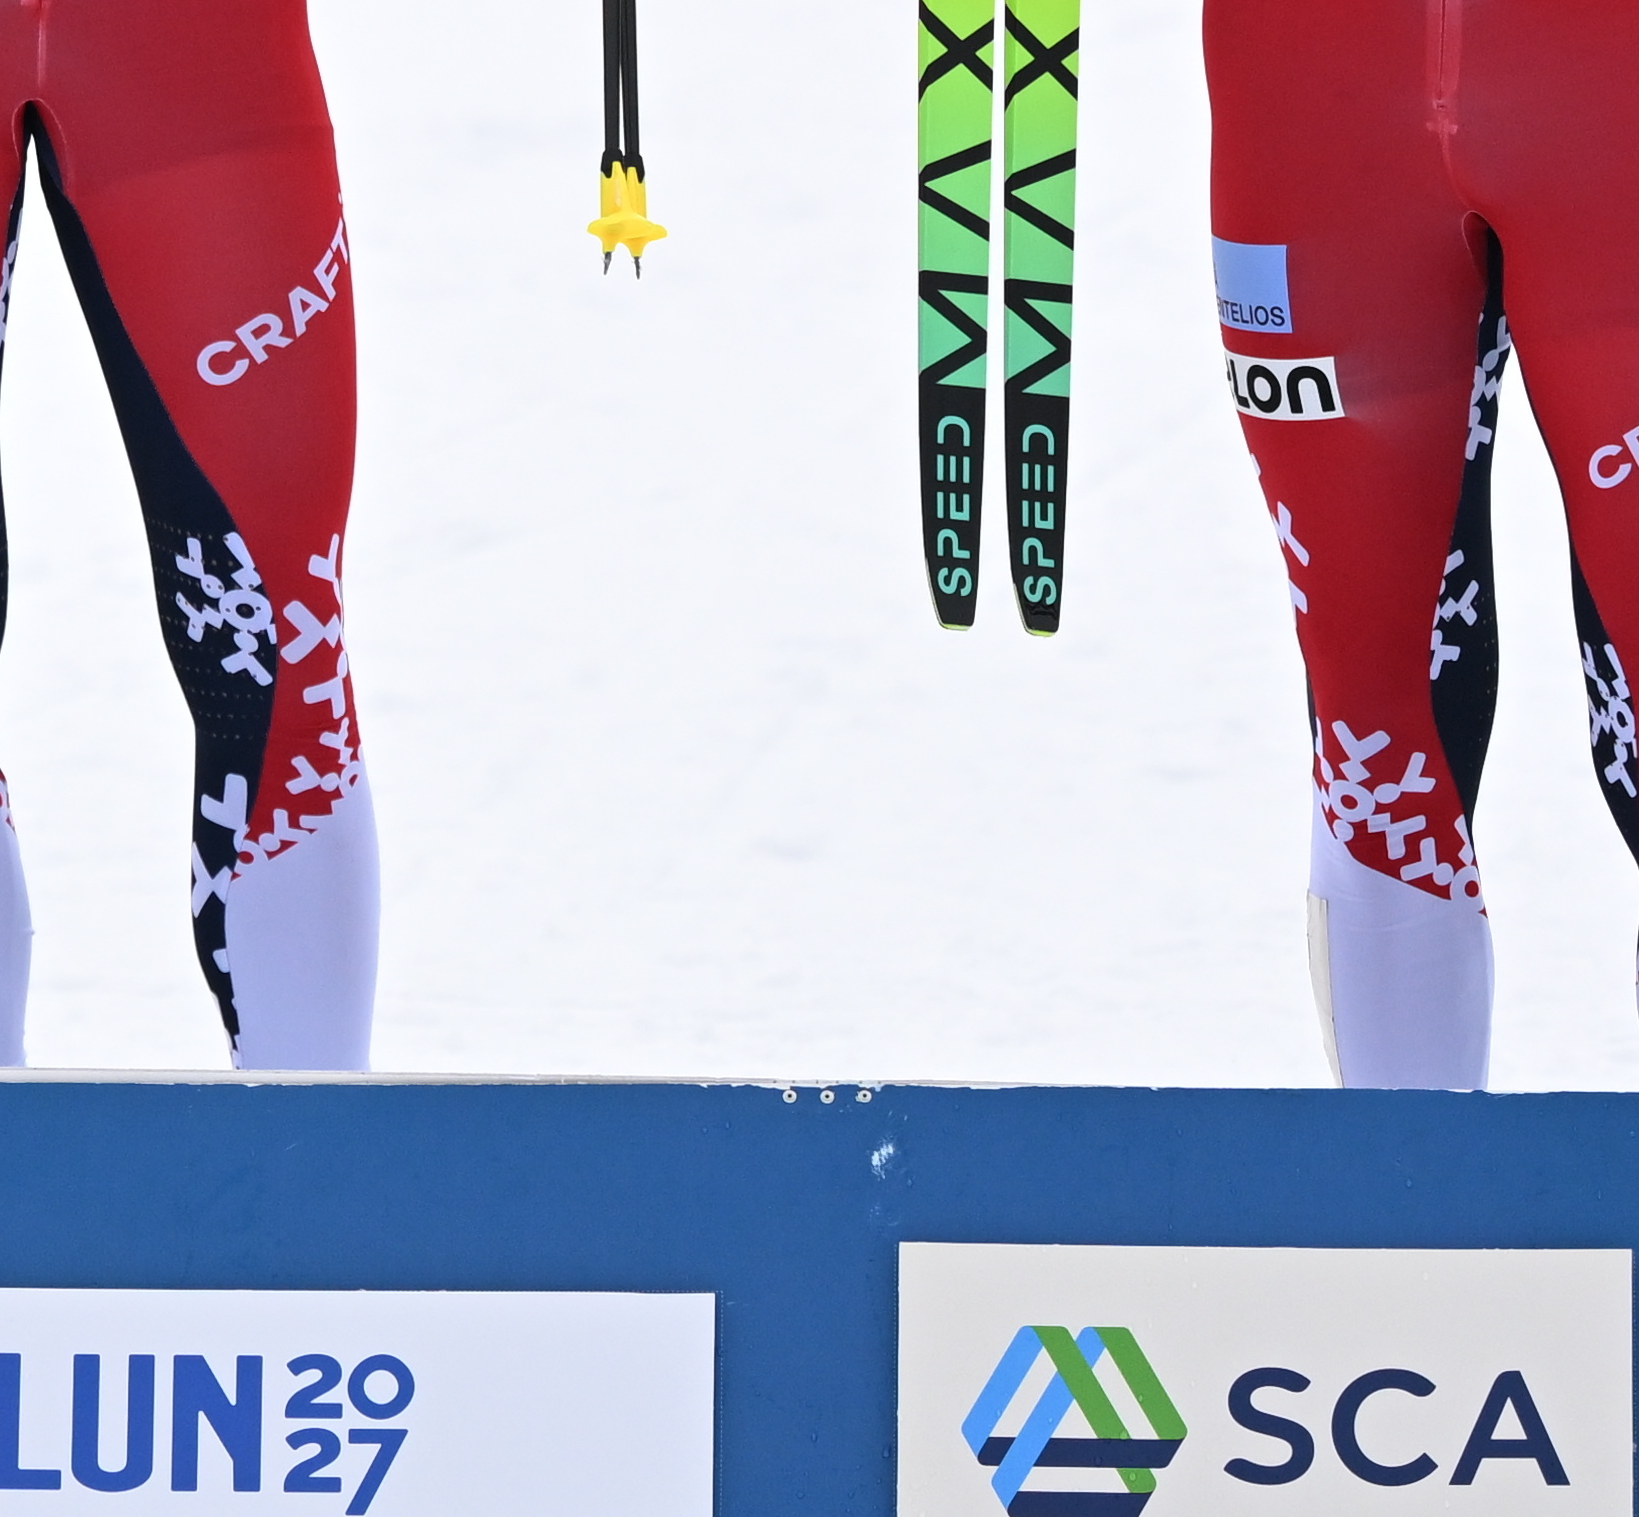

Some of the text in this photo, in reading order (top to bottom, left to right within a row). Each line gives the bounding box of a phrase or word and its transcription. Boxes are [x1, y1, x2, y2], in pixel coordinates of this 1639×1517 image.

[196, 218, 352, 388] CRAFT
[1004, 3, 1079, 607] SPEED MAX
[937, 415, 972, 597] SPEED
[284, 1353, 416, 1423] 20
[1223, 1367, 1571, 1487] SCA
[284, 1427, 409, 1515] 27
